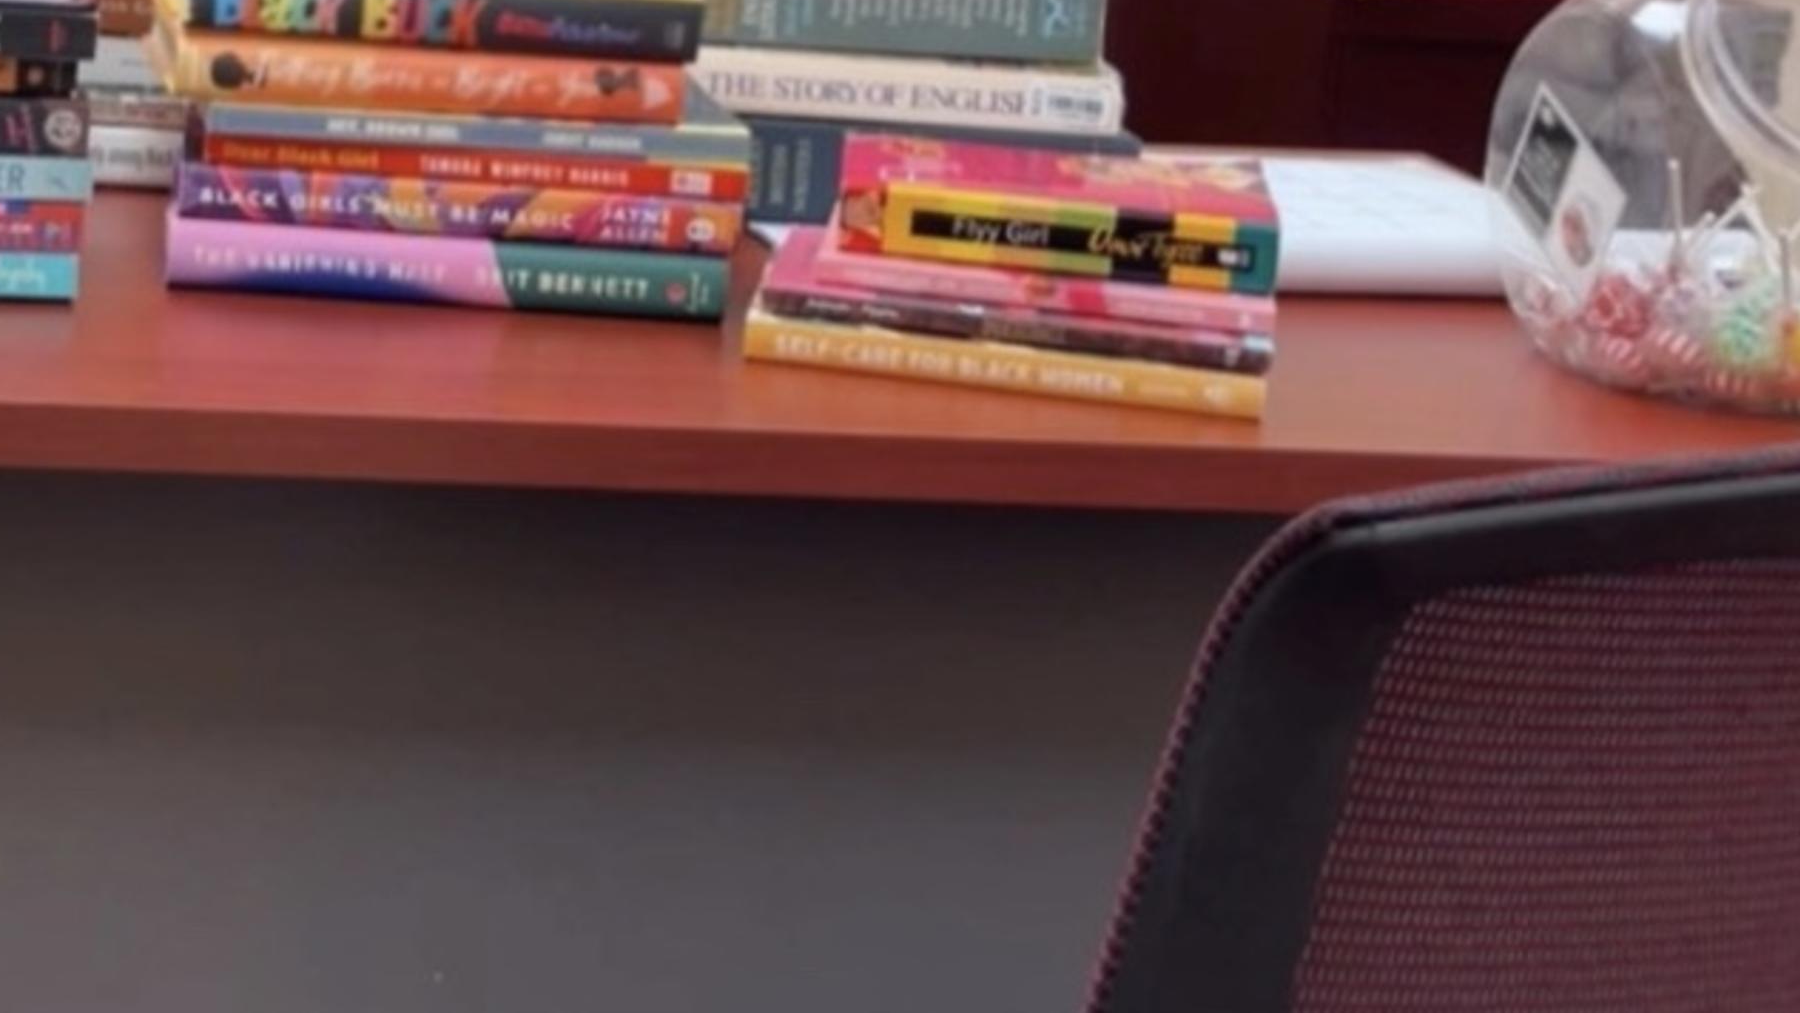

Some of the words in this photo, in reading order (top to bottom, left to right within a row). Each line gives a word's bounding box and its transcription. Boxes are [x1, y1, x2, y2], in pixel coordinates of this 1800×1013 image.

[707, 70, 762, 99] THE
[772, 75, 860, 105] STORY
[864, 79, 899, 108] OF
[277, 145, 332, 165] Black
[337, 147, 380, 167] Girl
[199, 188, 280, 209] BLACK
[289, 192, 361, 214] GIRLS
[373, 198, 439, 219] MUST
[450, 204, 479, 223] BE
[490, 208, 576, 231] MAGIC
[952, 217, 1001, 247] Flyy
[1006, 220, 1050, 244] Girl
[536, 271, 650, 299] BENNETT
[775, 334, 903, 367] SELF-CARE
[906, 350, 952, 375] FOR
[958, 355, 1029, 382] BLACK
[1039, 367, 1125, 395] WOMEN
